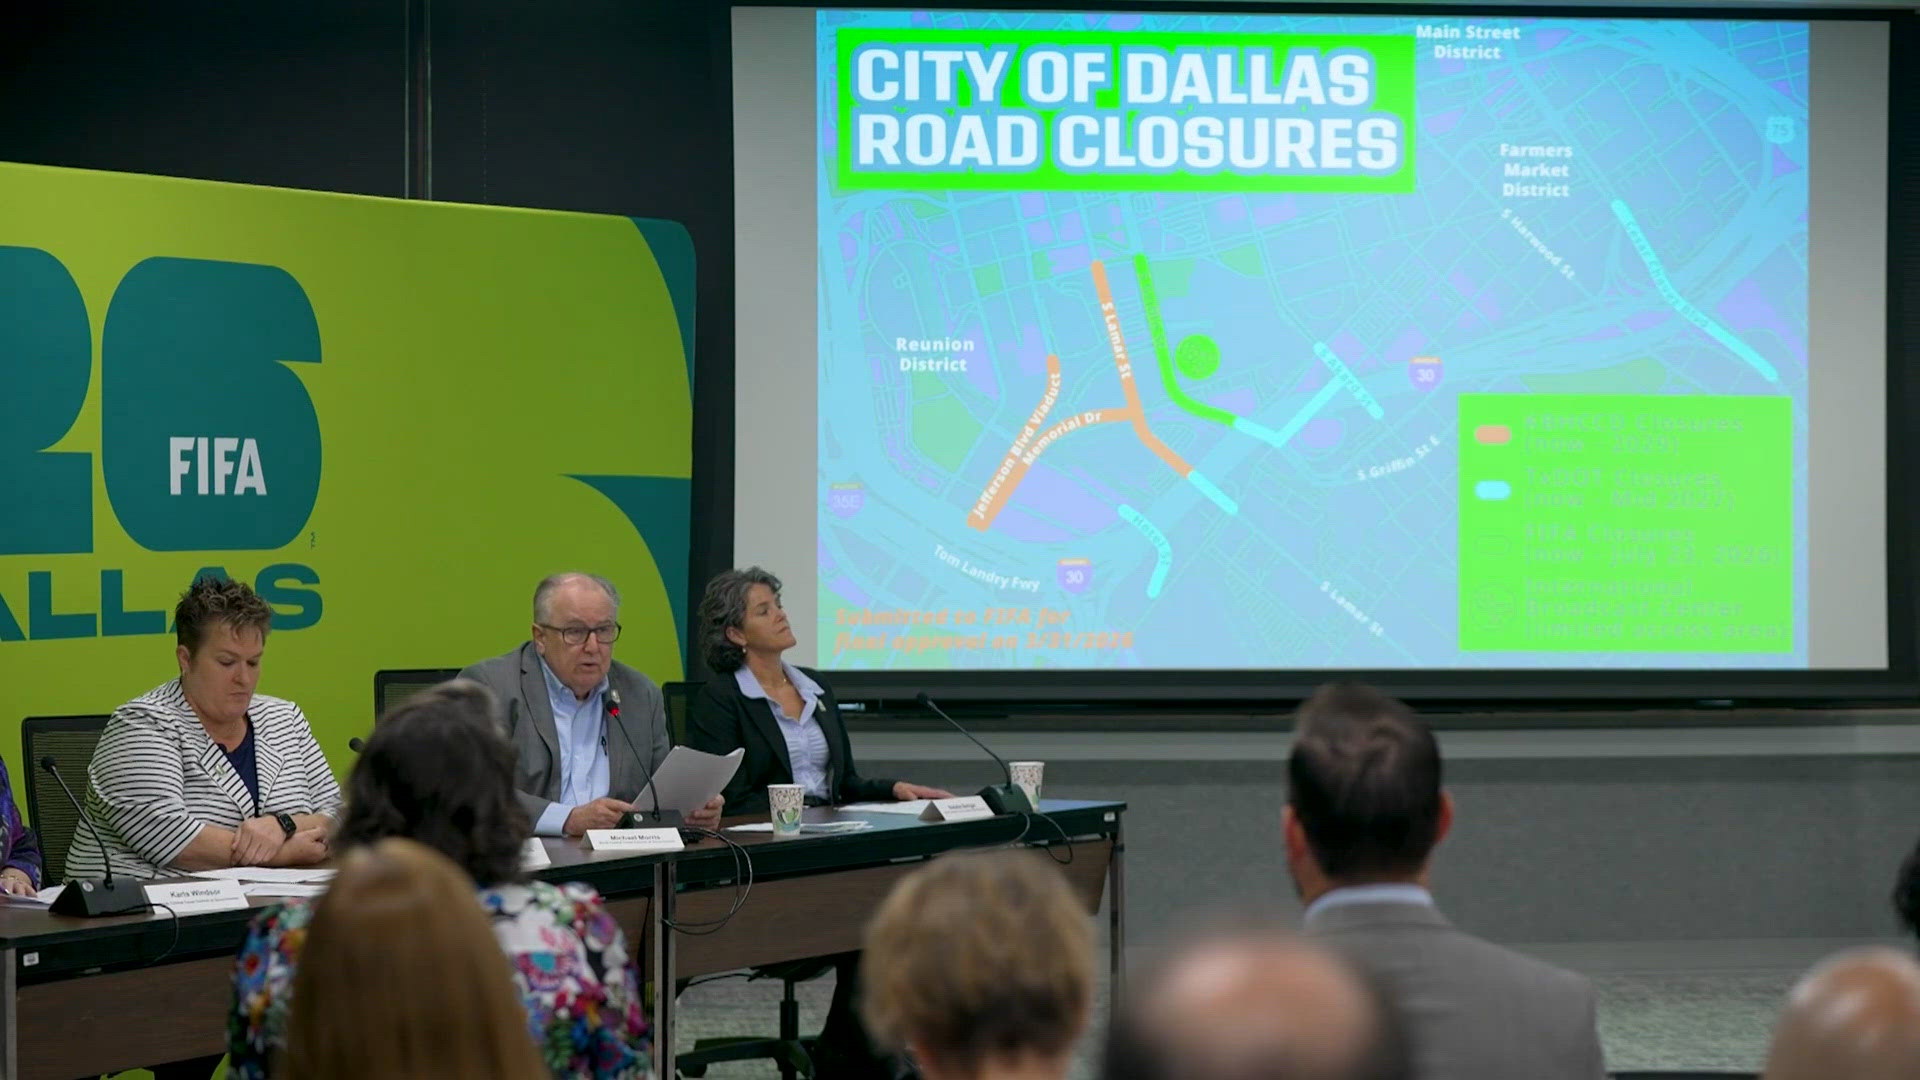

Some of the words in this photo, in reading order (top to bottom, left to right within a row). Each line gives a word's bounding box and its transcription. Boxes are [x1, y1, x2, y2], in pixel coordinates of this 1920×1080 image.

[1416, 25, 1461, 40] Main
[1465, 26, 1520, 41] Street
[1433, 45, 1501, 60] District
[859, 49, 1007, 103] CITY
[1028, 51, 1105, 104] OF
[1128, 53, 1369, 105] DALLAS
[860, 114, 1038, 167] ROAD
[1060, 115, 1397, 169] CLOSURES
[1499, 143, 1573, 159] Farmers
[1503, 162, 1569, 178] Market
[1502, 182, 1569, 198] District
[1501, 208, 1512, 219] S
[1511, 216, 1563, 266] Harwood
[1560, 263, 1576, 280] St
[1101, 302, 1114, 311] S
[896, 337, 975, 353] Reunion
[1105, 314, 1126, 360] Lamar
[899, 357, 968, 372] District
[1118, 363, 1132, 380] St
[1416, 368, 1435, 383] 30
[1636, 413, 1744, 432] Closures
[972, 457, 1016, 520] Jefferson
[1010, 425, 1034, 458] Blvd
[1029, 373, 1061, 424] Viaduct
[1022, 415, 1081, 466] Memorial
[1083, 411, 1103, 425] Dr
[169, 437, 267, 495] FIFA
[1613, 468, 1723, 489] Closures
[1588, 523, 1697, 543] Closures
[935, 543, 961, 569] Tom
[961, 560, 1010, 589] Landry
[1011, 575, 1041, 593] Fwy
[1065, 569, 1085, 585] 30
[836, 608, 949, 625] Submitted
[954, 612, 977, 625] to
[983, 608, 1031, 625] FIFA
[1036, 607, 1072, 629] for
[1329, 588, 1369, 624] Lamar
[1368, 621, 1385, 638] St
[833, 631, 888, 655] final
[892, 632, 989, 655] approval
[992, 638, 1019, 650] on
